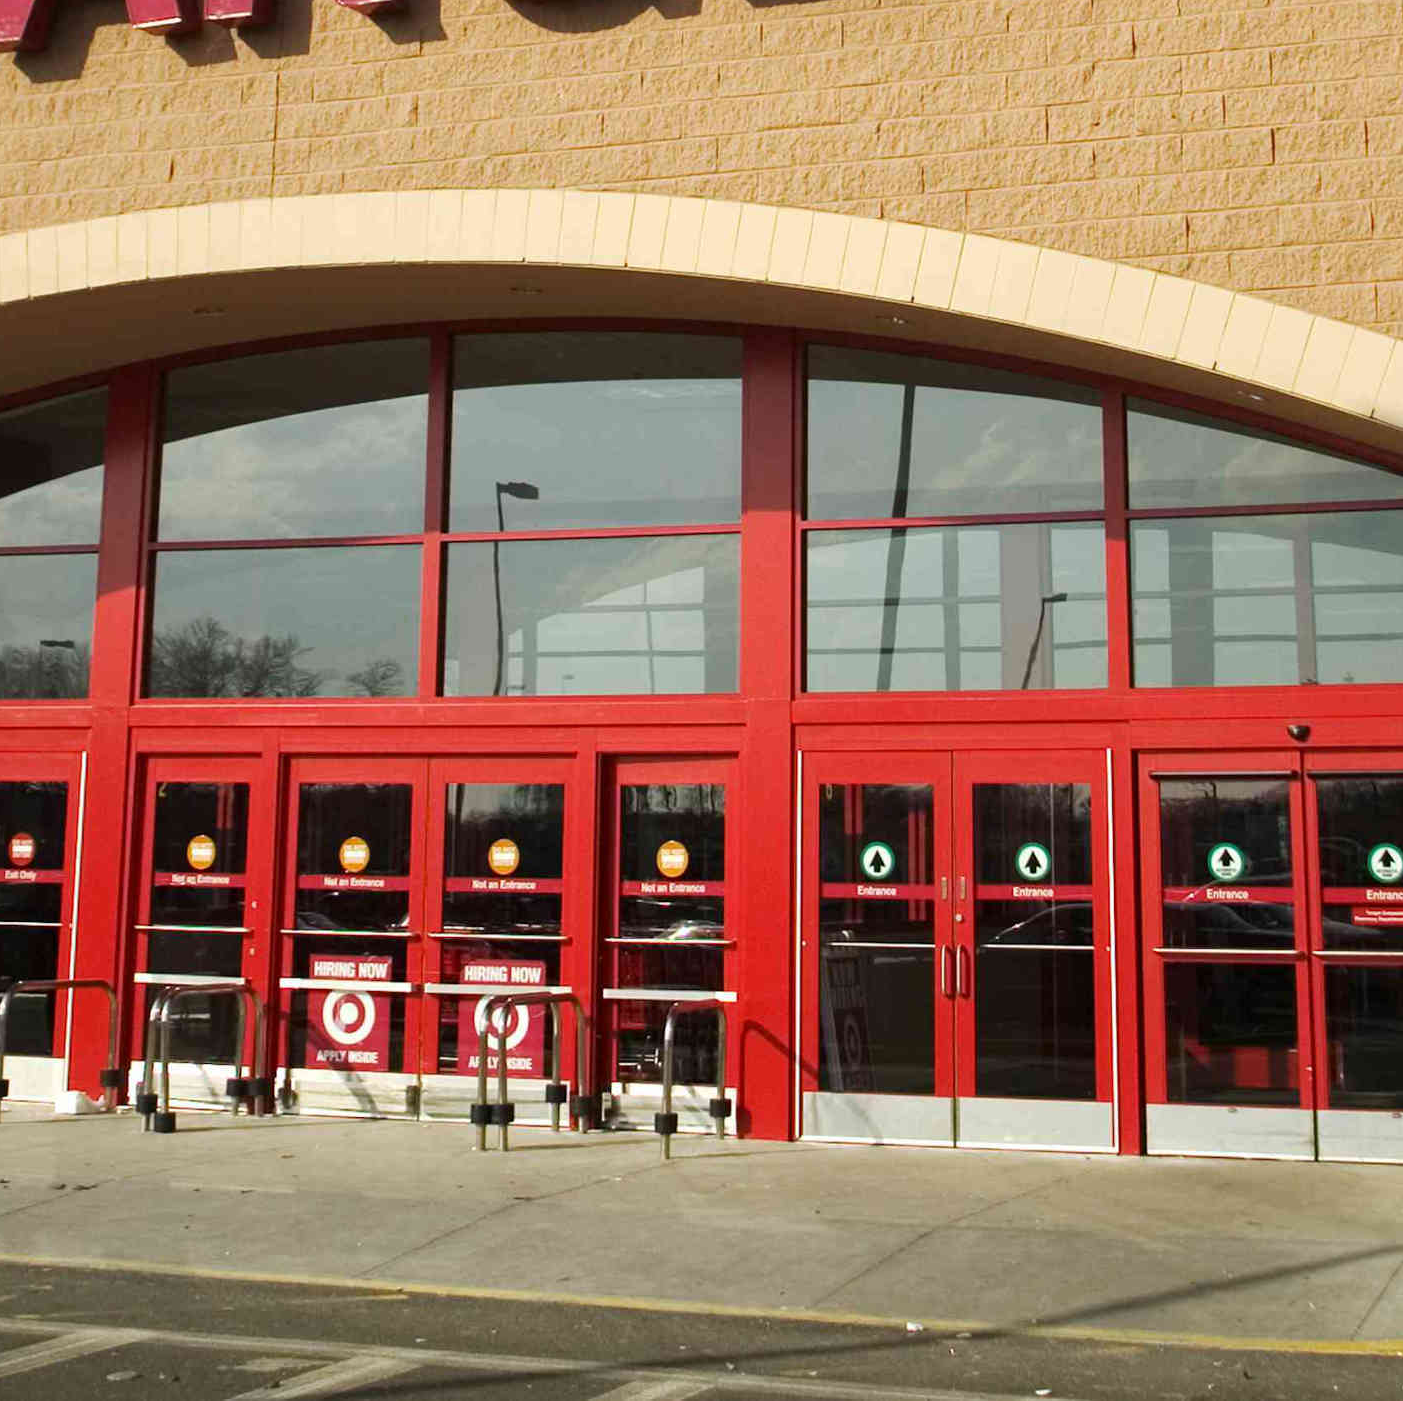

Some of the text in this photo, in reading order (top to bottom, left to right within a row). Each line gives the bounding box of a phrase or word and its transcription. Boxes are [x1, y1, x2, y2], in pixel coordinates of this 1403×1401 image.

[20, 871, 37, 881] Only
[350, 877, 385, 887] Entrance
[500, 880, 536, 890] Entrance
[669, 883, 706, 894] Entrance
[857, 885, 896, 896] Entrance
[1013, 887, 1054, 898] Entrance
[1206, 888, 1249, 900] Entrance
[314, 961, 388, 978] HIRING NOW
[464, 965, 541, 983] HIRING NOW
[316, 1049, 379, 1064] APPLY INSIDE
[468, 1055, 499, 1069] APLY
